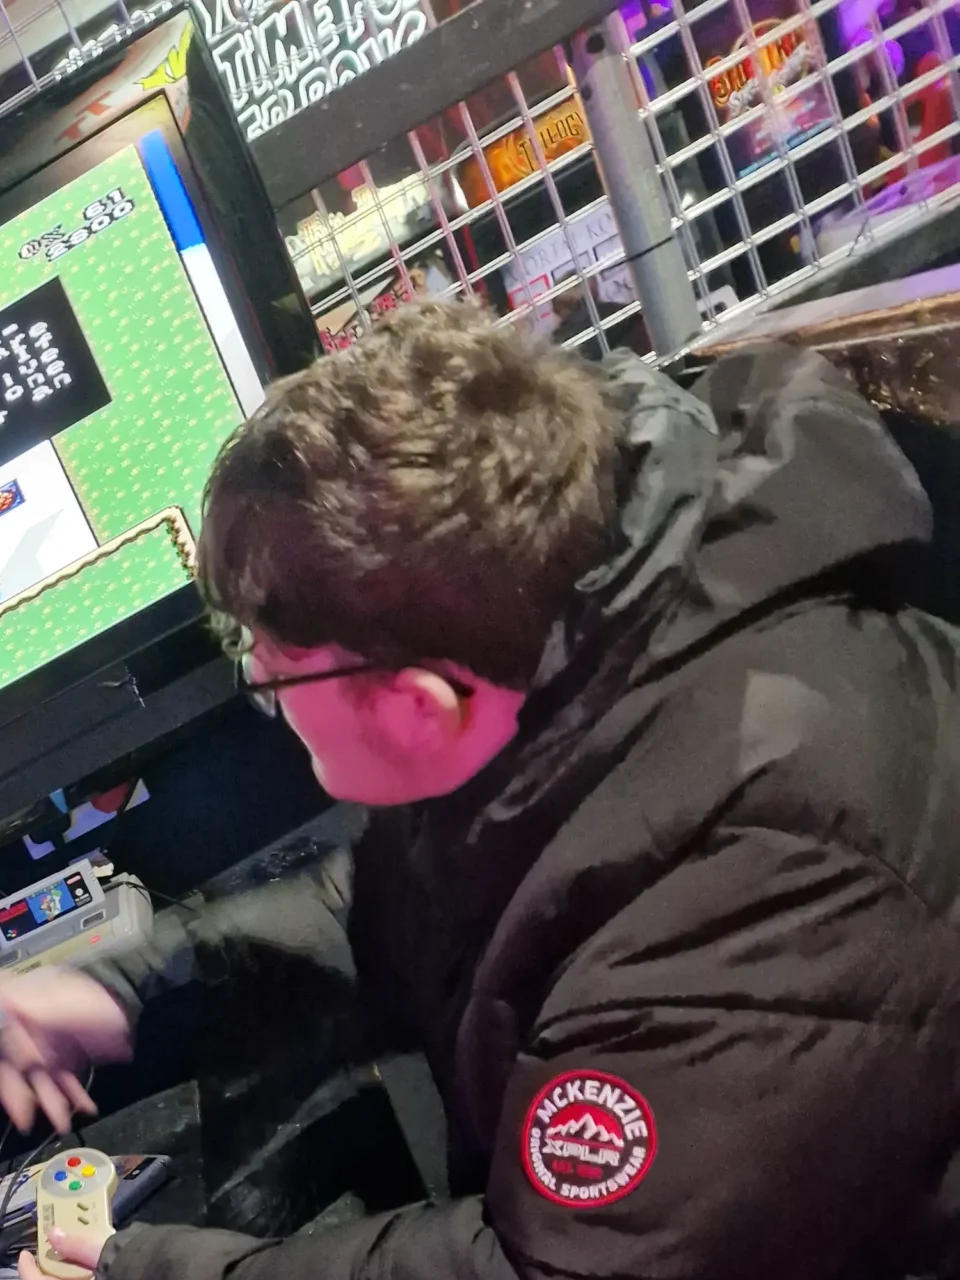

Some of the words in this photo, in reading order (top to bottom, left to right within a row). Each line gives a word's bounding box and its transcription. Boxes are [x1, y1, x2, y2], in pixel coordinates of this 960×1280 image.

[13, 331, 52, 363] If
[3, 359, 64, 401] one
[31, 372, 72, 402] an
[536, 1079, 648, 1141] MCKENZIE
